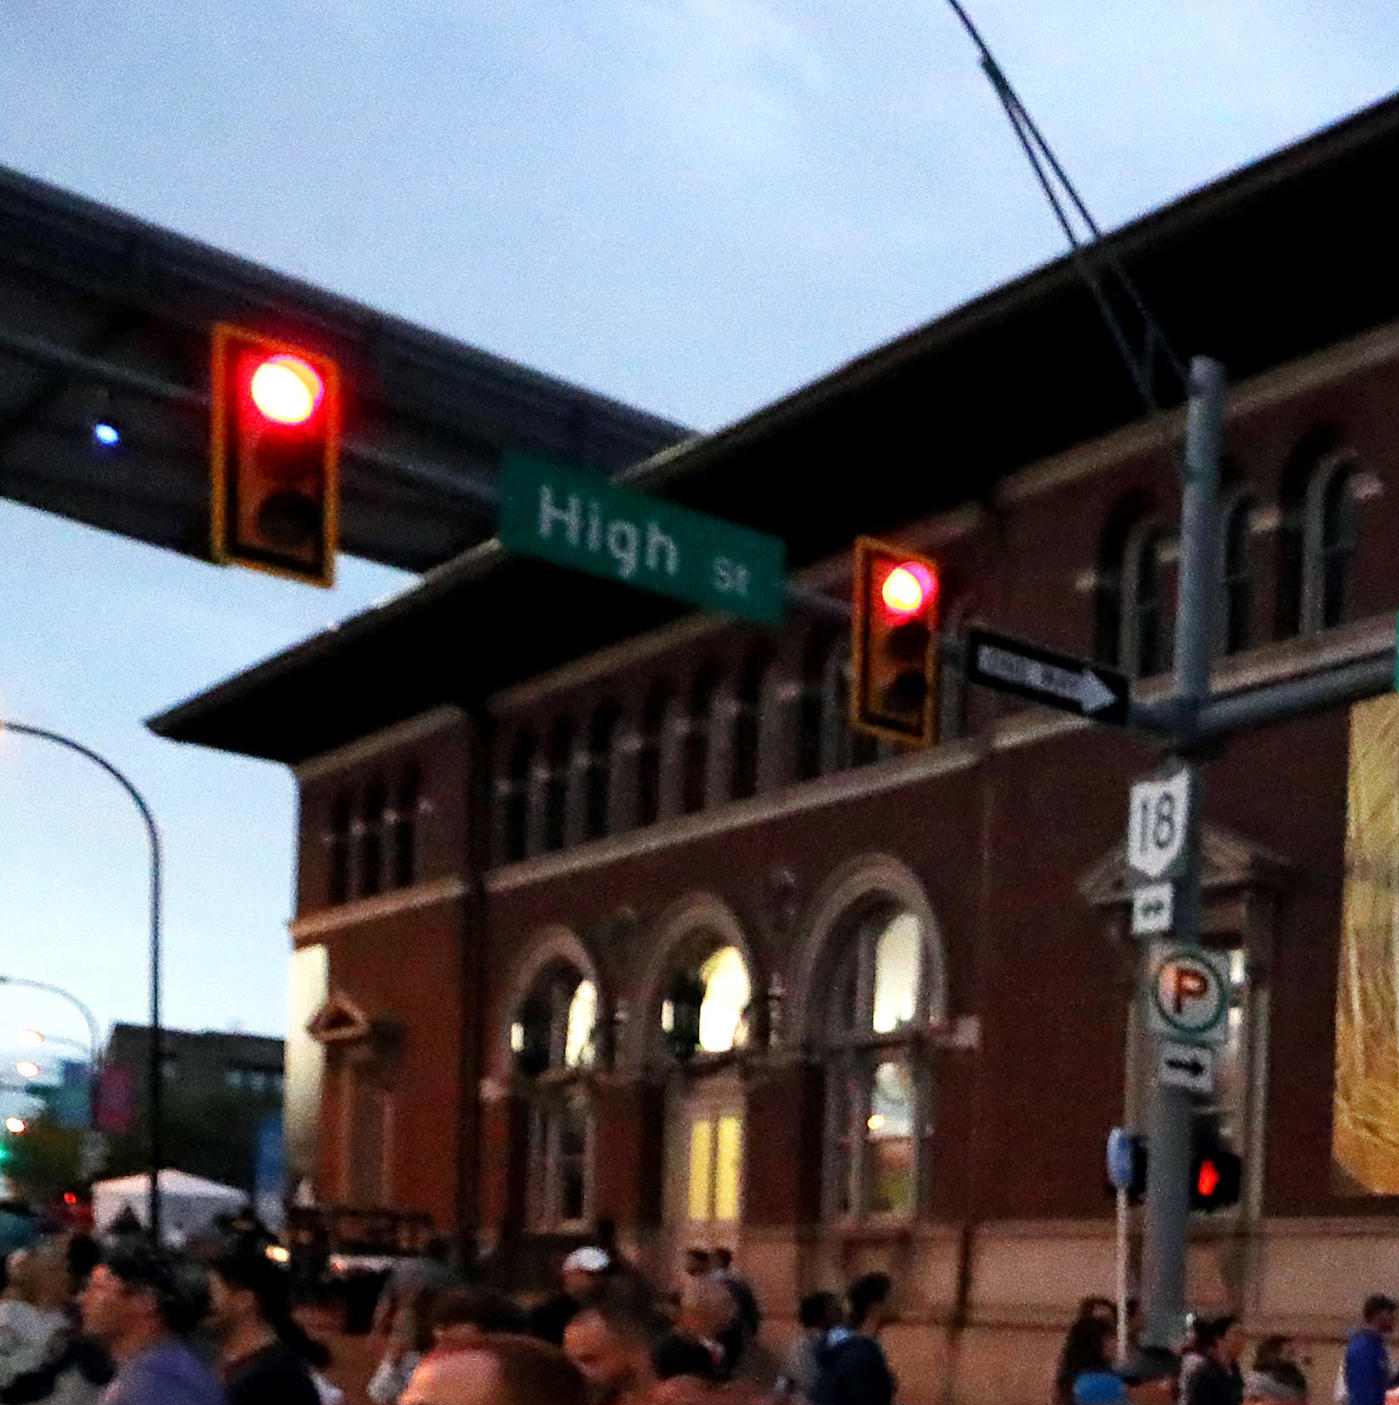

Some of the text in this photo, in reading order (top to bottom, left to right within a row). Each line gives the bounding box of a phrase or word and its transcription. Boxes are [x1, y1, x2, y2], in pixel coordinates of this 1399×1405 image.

[537, 484, 681, 580] High
[1140, 790, 1175, 850] 18
[1173, 968, 1207, 1014] P
